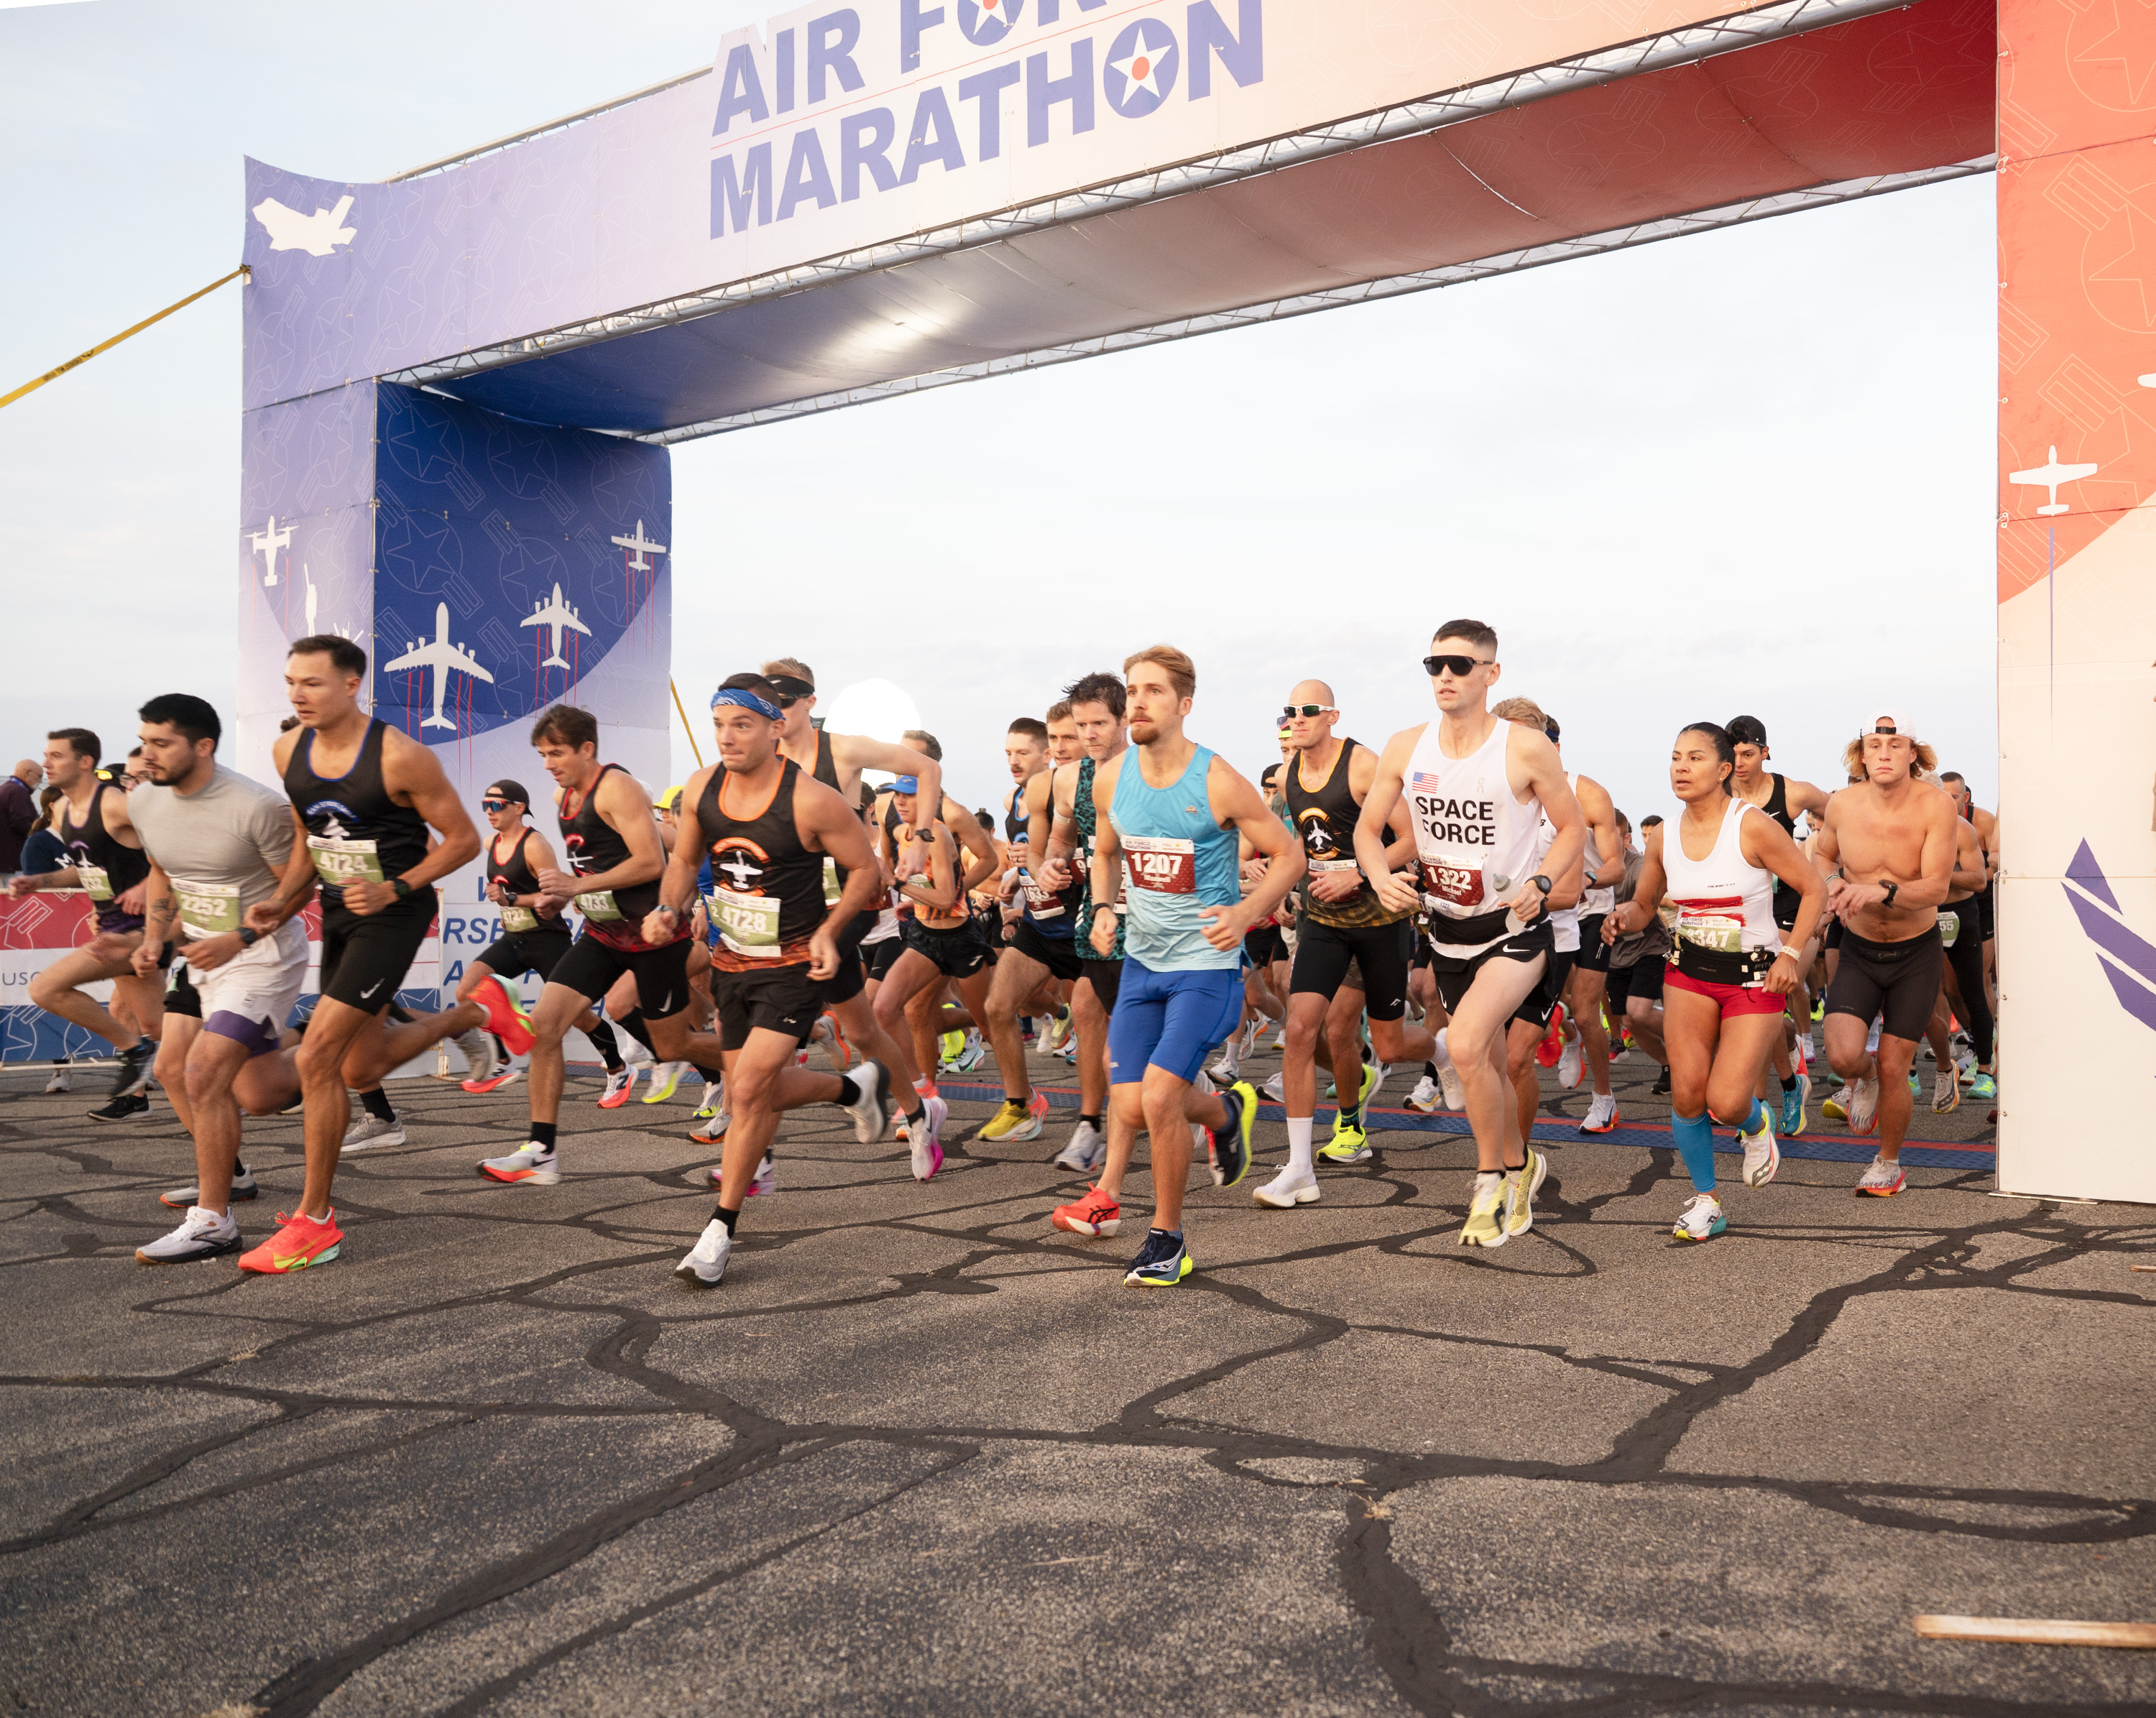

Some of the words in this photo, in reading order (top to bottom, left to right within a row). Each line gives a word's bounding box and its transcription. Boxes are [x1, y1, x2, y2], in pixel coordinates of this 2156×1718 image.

[712, 4, 865, 137] AIR
[710, 0, 1263, 239] MARATHON
[1416, 796, 1493, 821] SPACE
[1131, 852, 1183, 875] 1207
[1427, 867, 1473, 890] 1322
[1442, 885, 1462, 896] Michael
[722, 905, 768, 933] 4728
[1687, 928, 1730, 948] 3347
